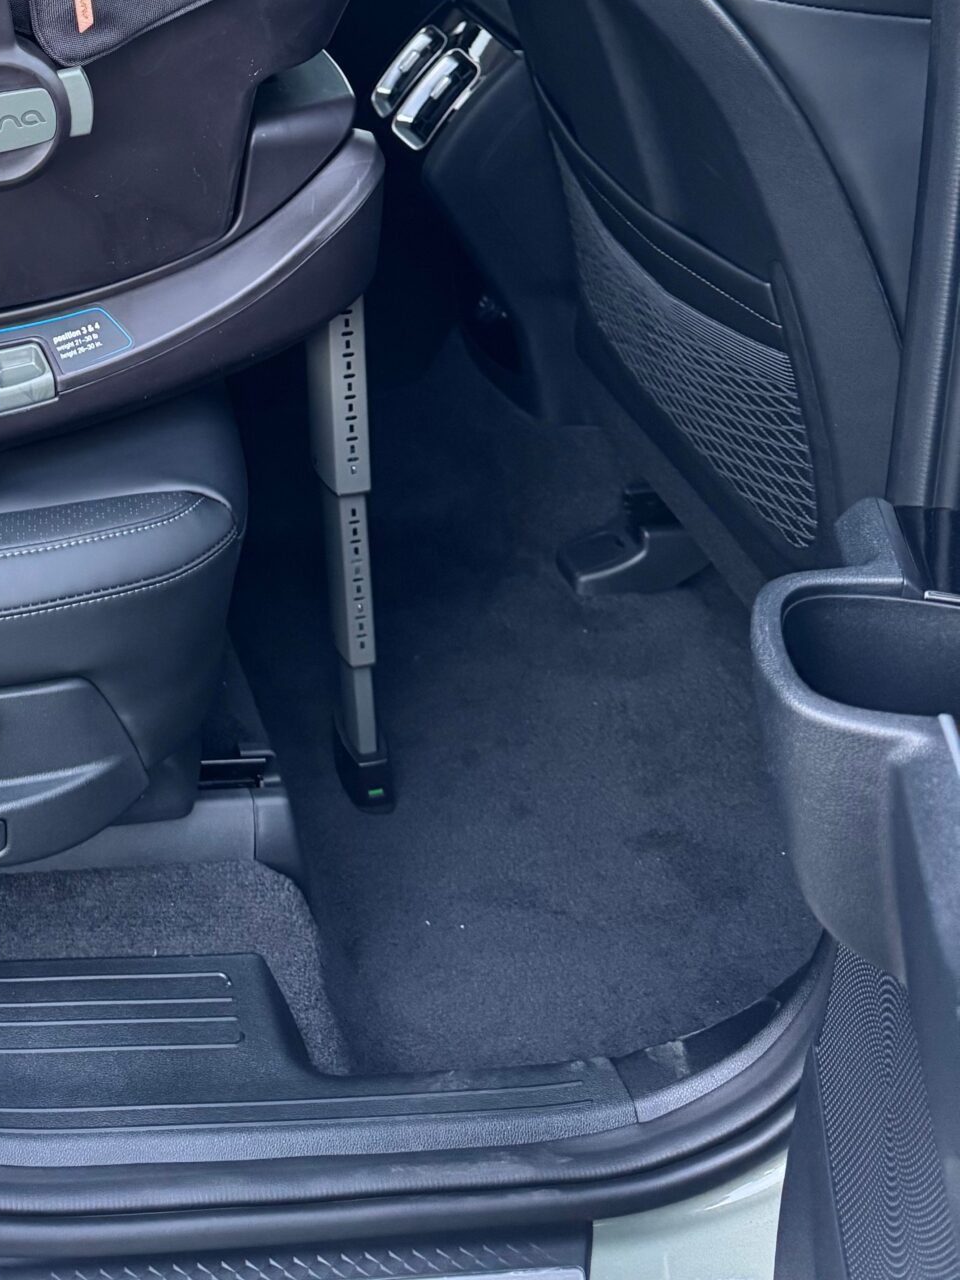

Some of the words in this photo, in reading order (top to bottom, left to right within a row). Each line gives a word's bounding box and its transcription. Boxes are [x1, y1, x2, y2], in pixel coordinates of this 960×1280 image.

[53, 330, 81, 345] position
[81, 326, 87, 334] 3
[87, 324, 94, 332] &
